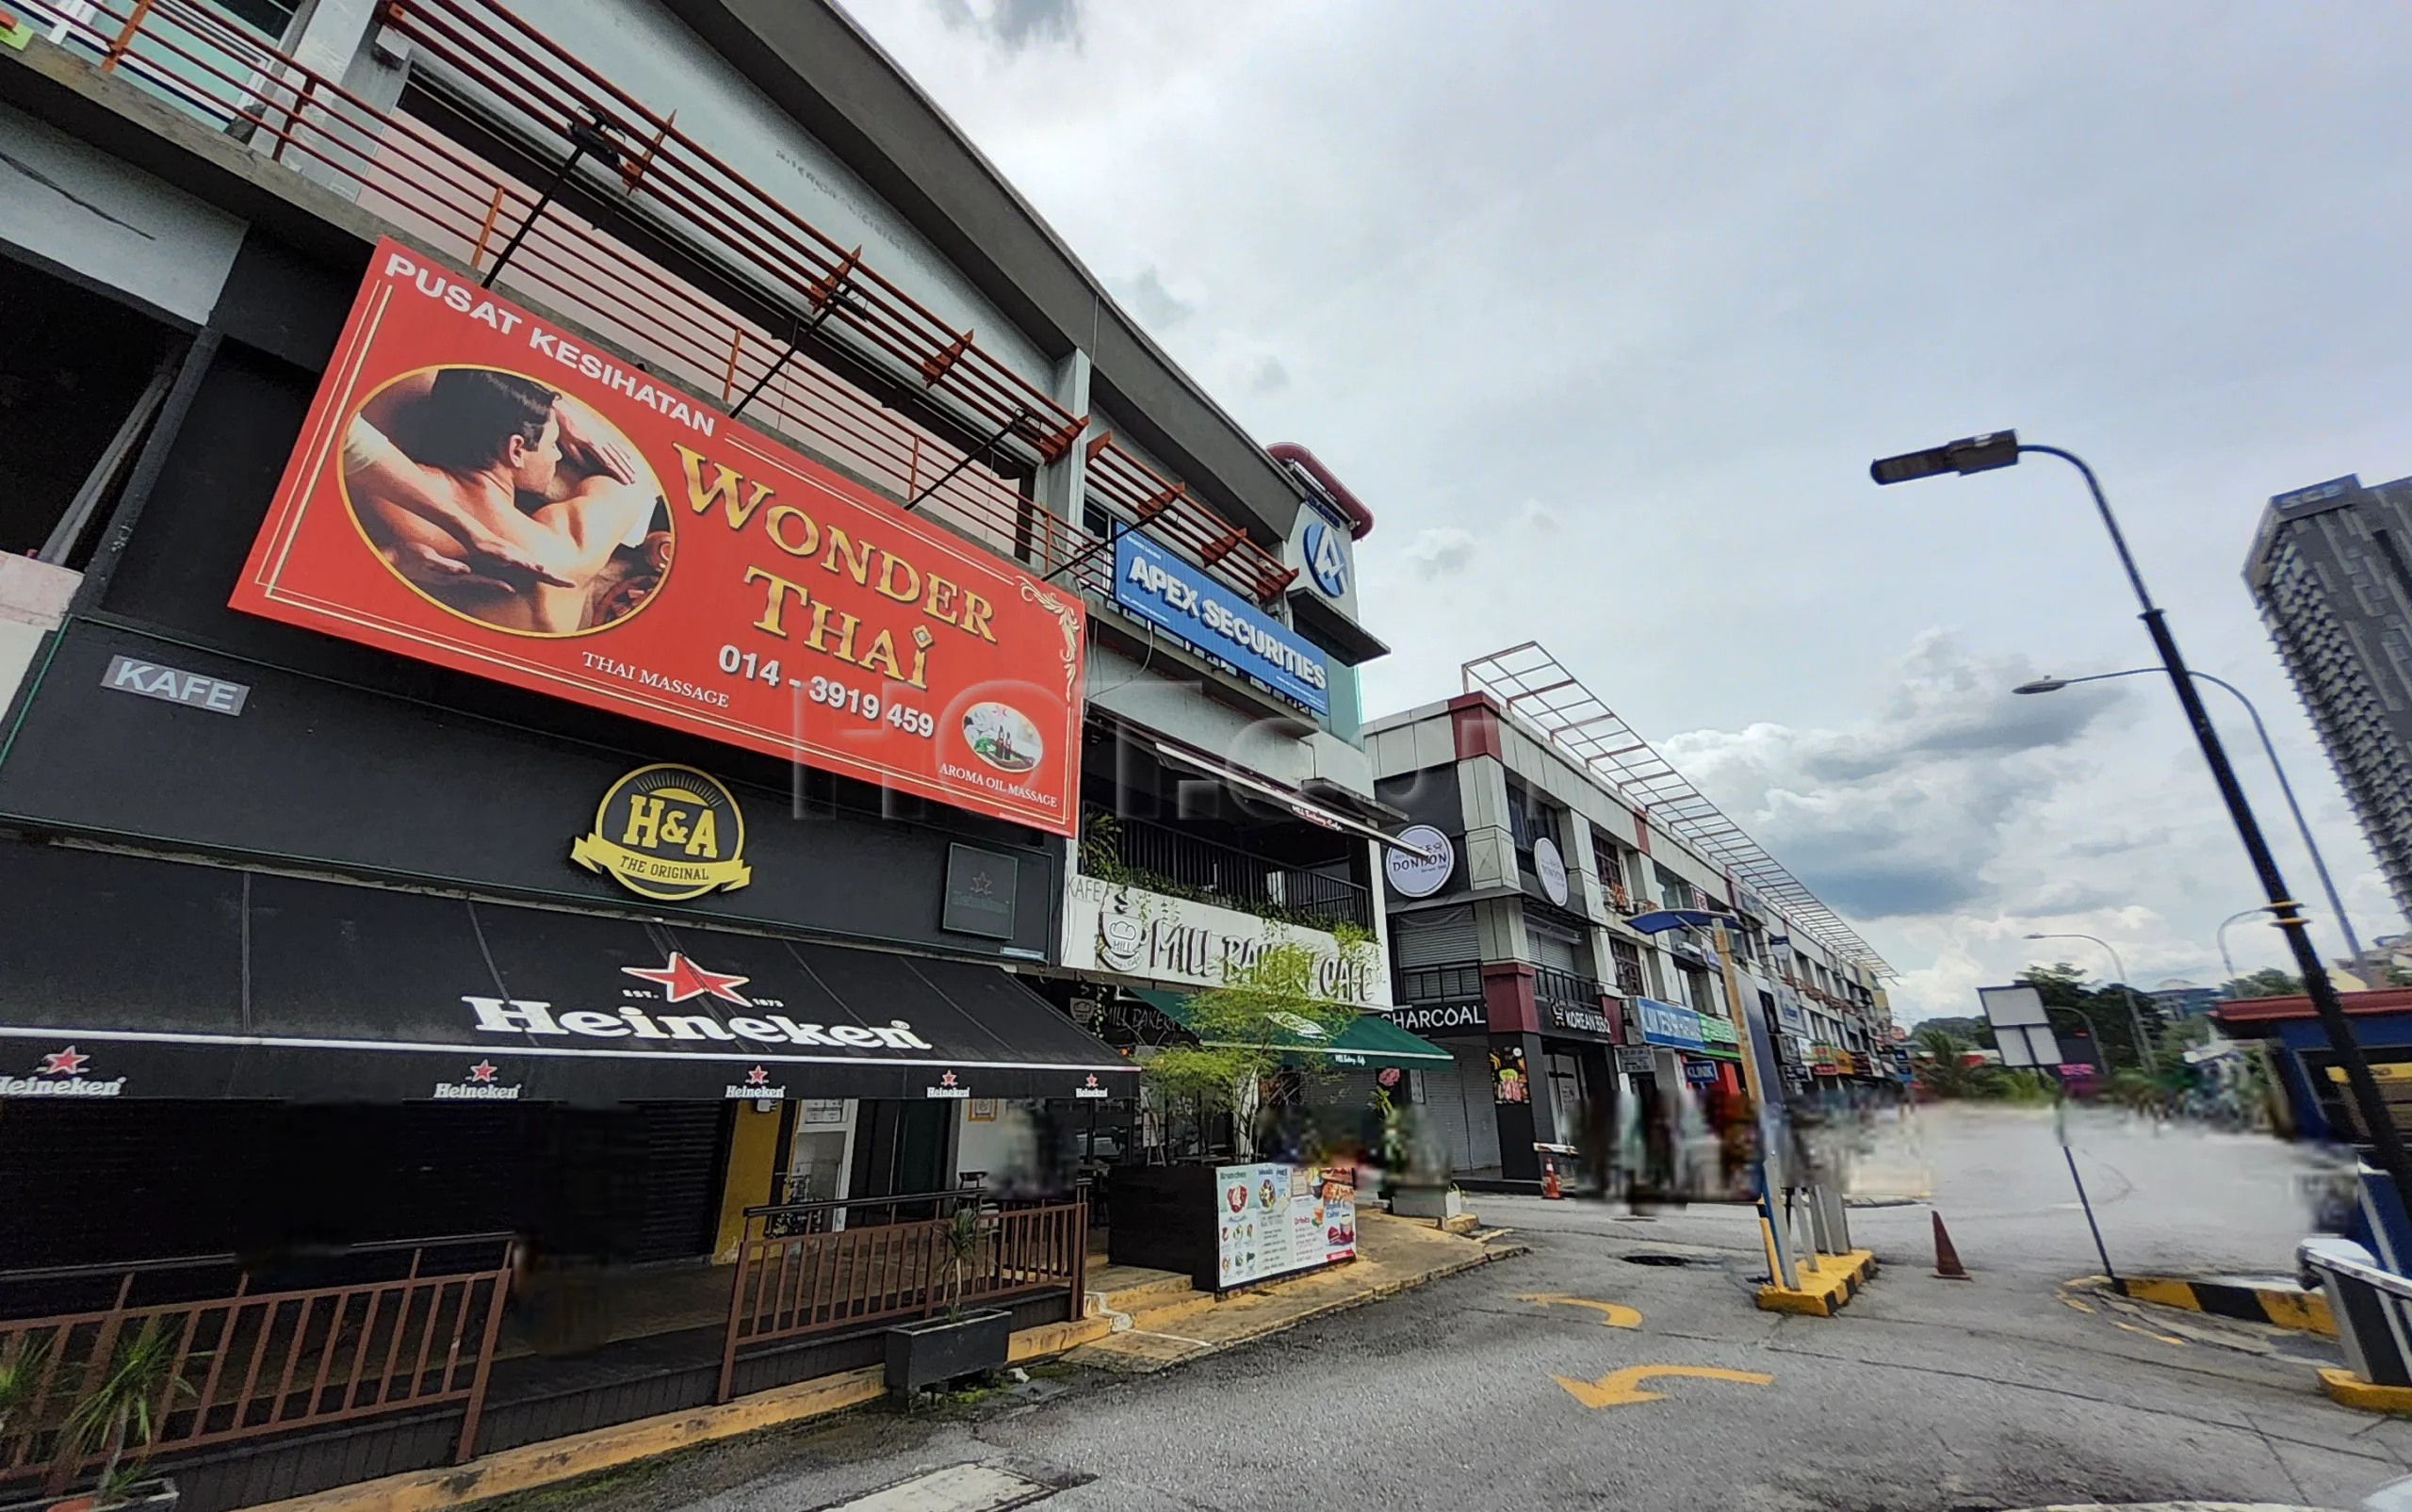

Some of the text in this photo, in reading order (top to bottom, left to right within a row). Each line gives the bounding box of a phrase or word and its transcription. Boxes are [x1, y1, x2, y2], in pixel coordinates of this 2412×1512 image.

[384, 253, 714, 437] PUSAT KESIHATAN
[673, 442, 997, 644] WONDER
[1127, 556, 1327, 690] APEX SECURITIES
[114, 660, 238, 710] KAFE
[582, 651, 729, 708] THAI MASSAGE
[719, 644, 779, 686] 014
[809, 675, 880, 720] 3919
[887, 705, 934, 737] 459
[939, 762, 1057, 807] AROMA OIL MASSAGE
[623, 794, 718, 858] H&A
[619, 855, 709, 882] THE ORIGINAL
[1068, 876, 1100, 902] KAFE
[1113, 940, 1132, 953] MILL
[1149, 919, 1216, 977] MILL
[1319, 956, 1375, 1002] CAFE
[623, 989, 784, 1008] EST. 1873
[460, 995, 933, 1050] Heineken
[1565, 1010, 1612, 1034] KOREAN BBQ
[433, 1082, 521, 1100] Heineken
[725, 1084, 785, 1099] Heineken
[926, 1085, 970, 1098] Heineken
[1075, 1087, 1108, 1098] Heineken
